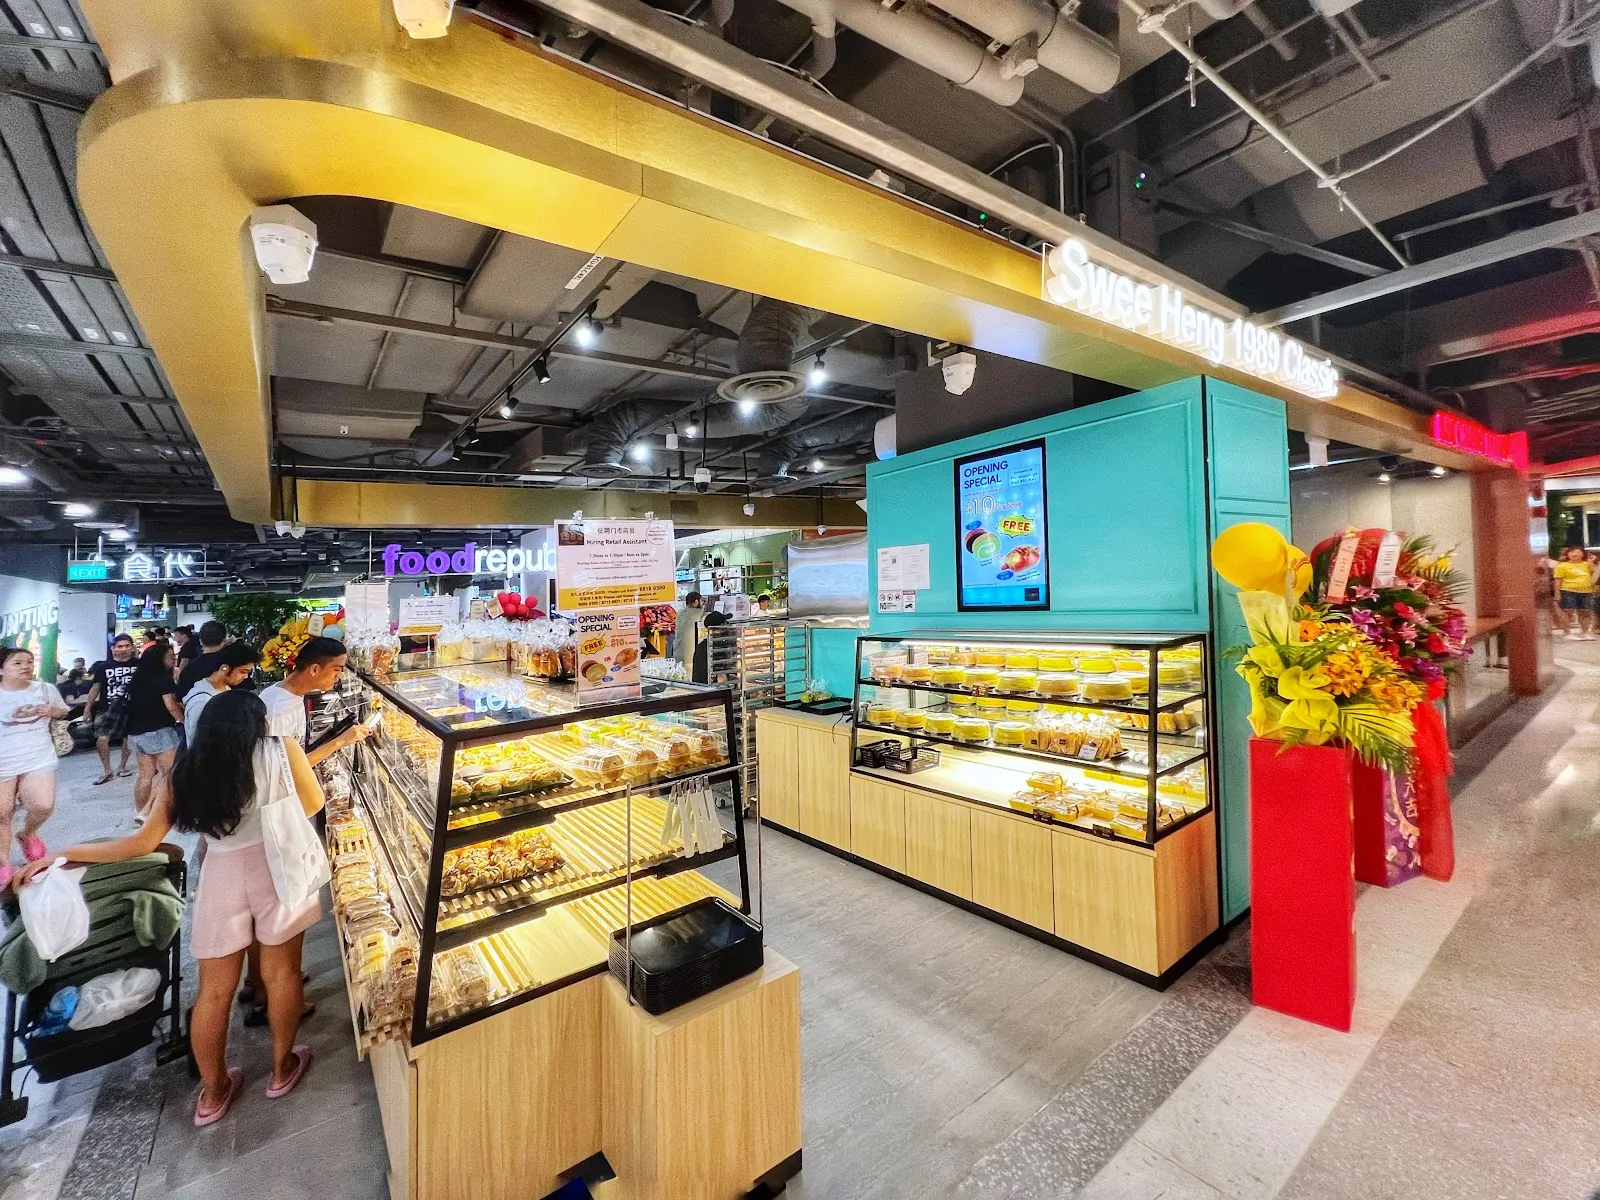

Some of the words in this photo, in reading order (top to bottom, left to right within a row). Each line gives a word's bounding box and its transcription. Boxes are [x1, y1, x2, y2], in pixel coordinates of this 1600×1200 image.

[1052, 238, 1153, 324] Swee
[1158, 283, 1225, 364] Heng
[1231, 317, 1280, 373] 1989
[1282, 338, 1339, 398] Classic
[964, 460, 1008, 477] OPENING
[964, 474, 1002, 489] SPECIAL
[965, 495, 994, 515] $10
[1003, 520, 1031, 532] FREE
[94, 552, 195, 579] 食代
[78, 568, 103, 577] EXIT
[578, 613, 615, 624] OPENING
[581, 623, 613, 633] SPECIAL
[584, 640, 603, 651] FREE
